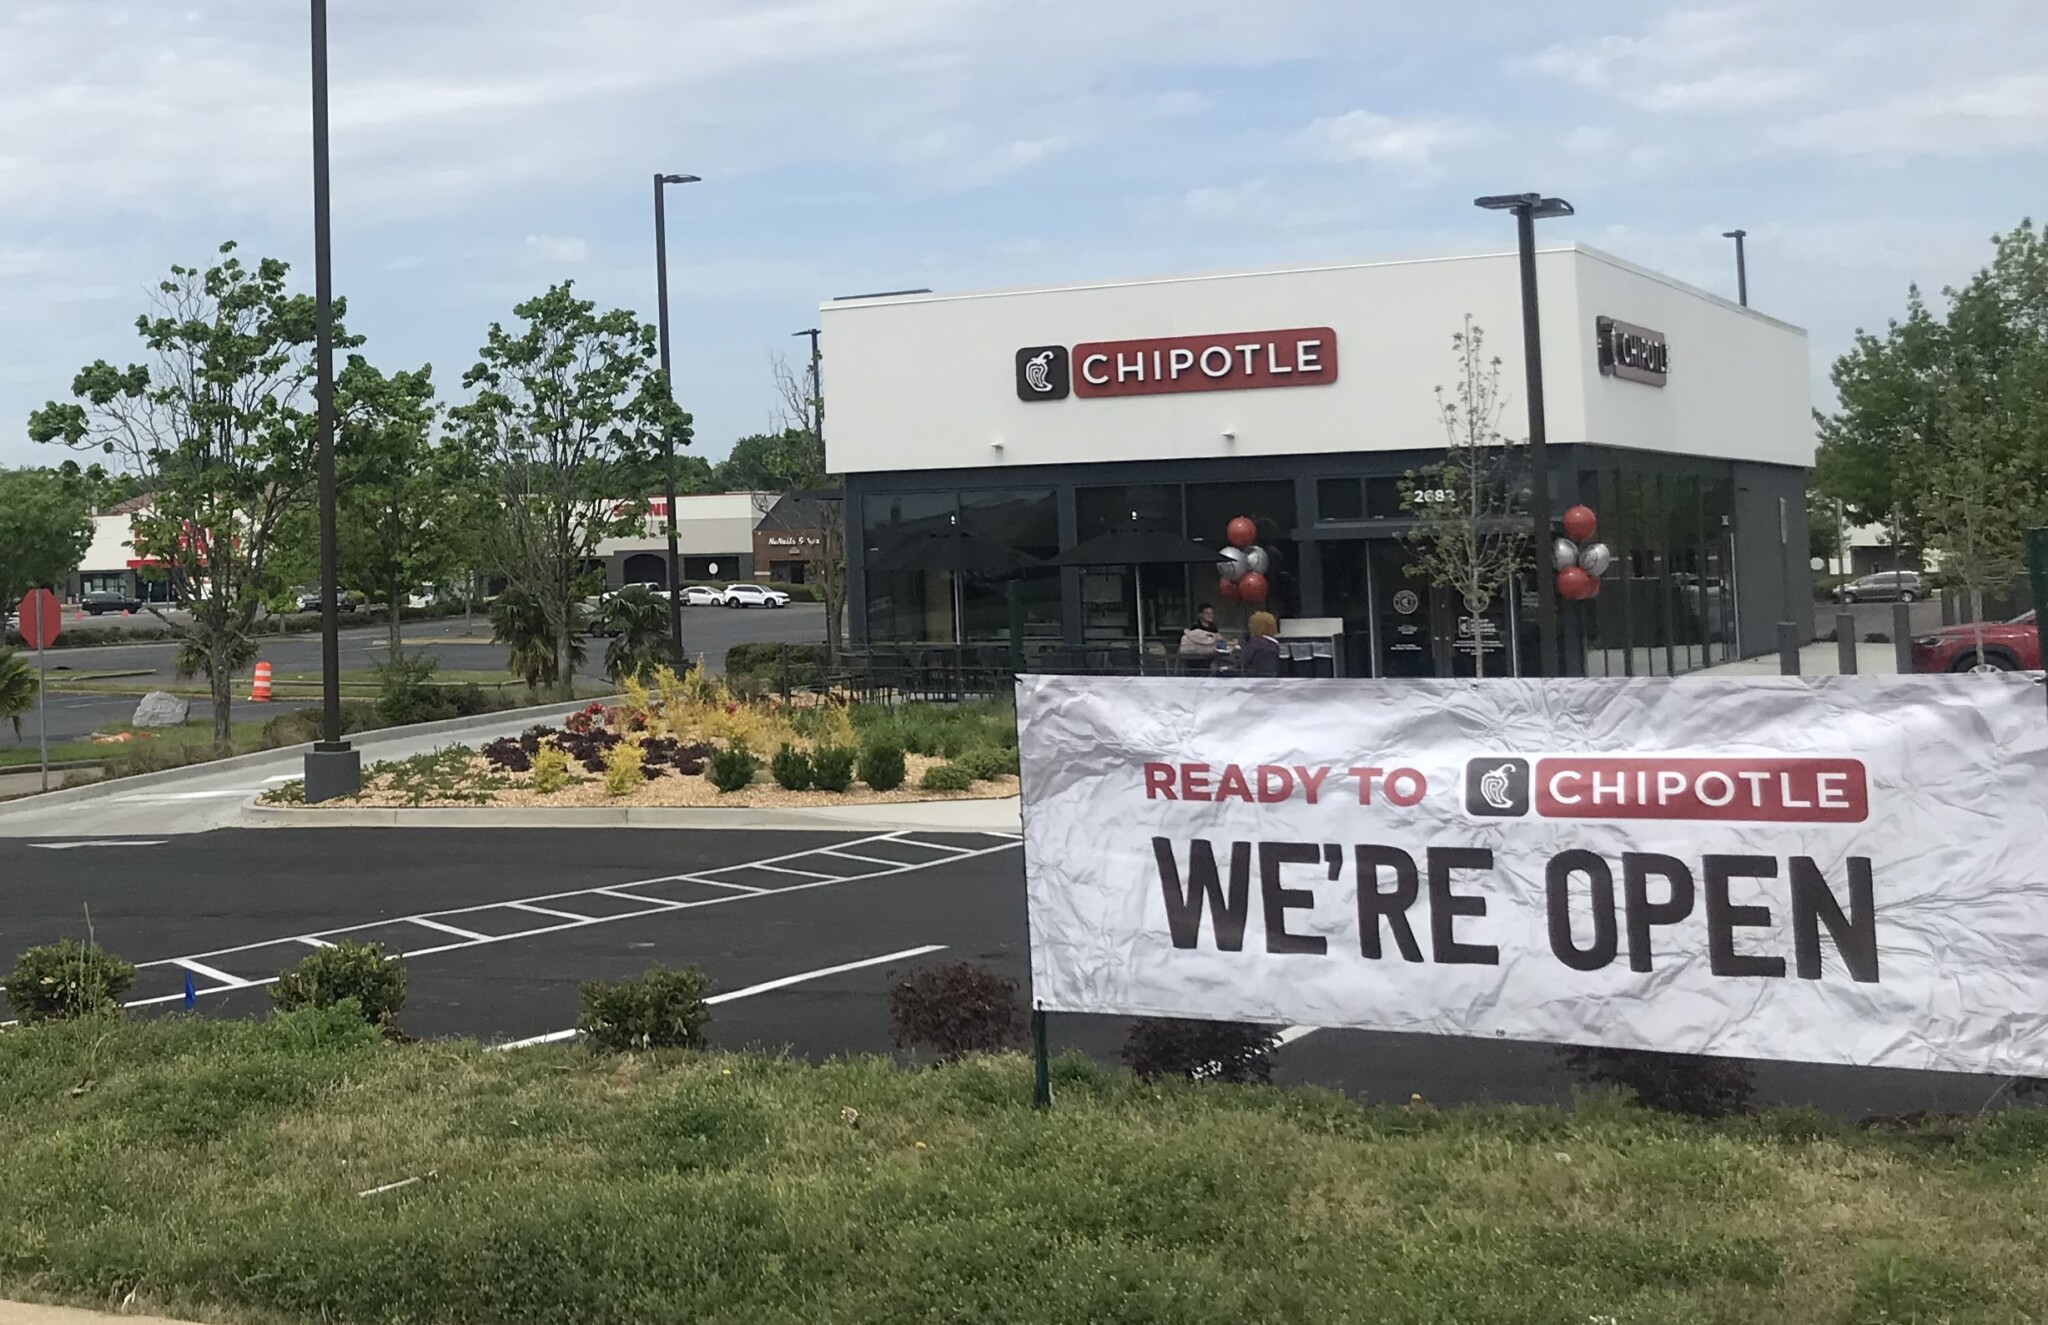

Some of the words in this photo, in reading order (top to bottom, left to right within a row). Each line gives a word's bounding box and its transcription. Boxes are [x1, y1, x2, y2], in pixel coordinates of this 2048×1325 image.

[1082, 340, 1322, 384] CHIPOTLE
[1144, 762, 1331, 804] READY
[1348, 767, 1427, 806] TO
[1549, 770, 1849, 808] CHIPOTLE
[1152, 836, 1499, 965] WE'RE
[1545, 848, 1880, 983] OPEN
